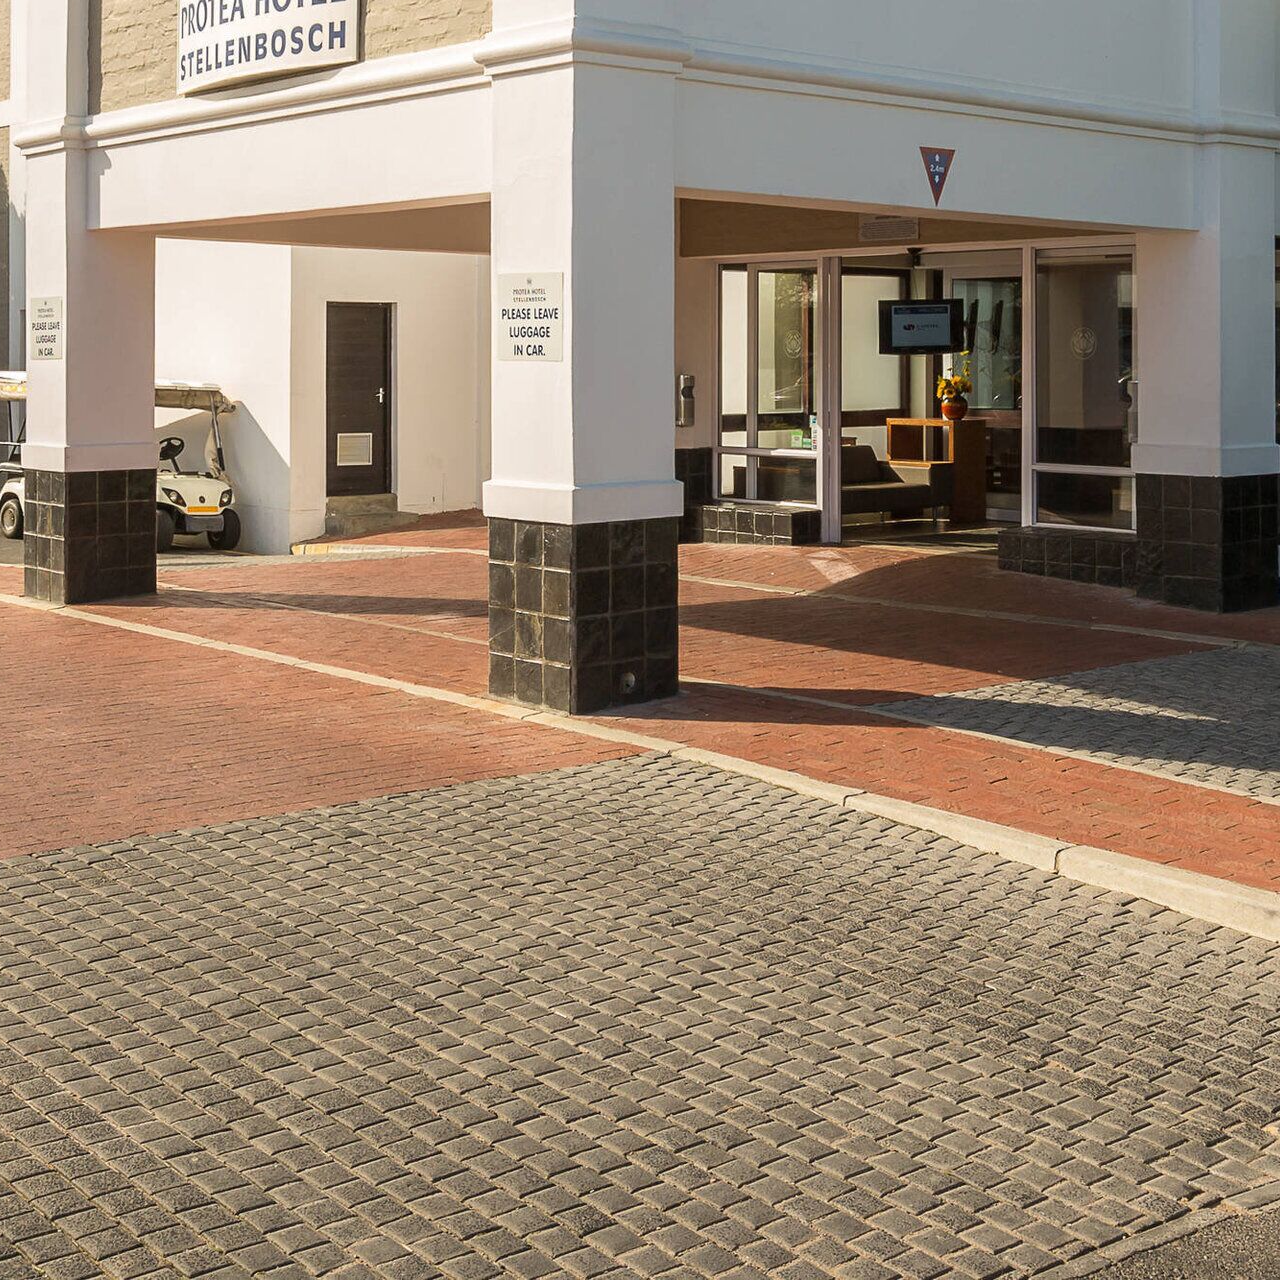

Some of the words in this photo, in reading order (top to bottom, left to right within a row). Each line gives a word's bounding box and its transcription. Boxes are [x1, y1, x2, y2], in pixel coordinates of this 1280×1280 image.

[180, 20, 346, 81] STELLENBOSCH
[501, 308, 531, 320] PLEASE
[534, 307, 559, 319] LEAVE
[32, 322, 47, 330] PLEASE
[48, 321, 60, 330] LEAVE
[509, 326, 551, 338] LUGGAGE
[513, 345, 523, 356] IN
[526, 344, 546, 356] CAR.
